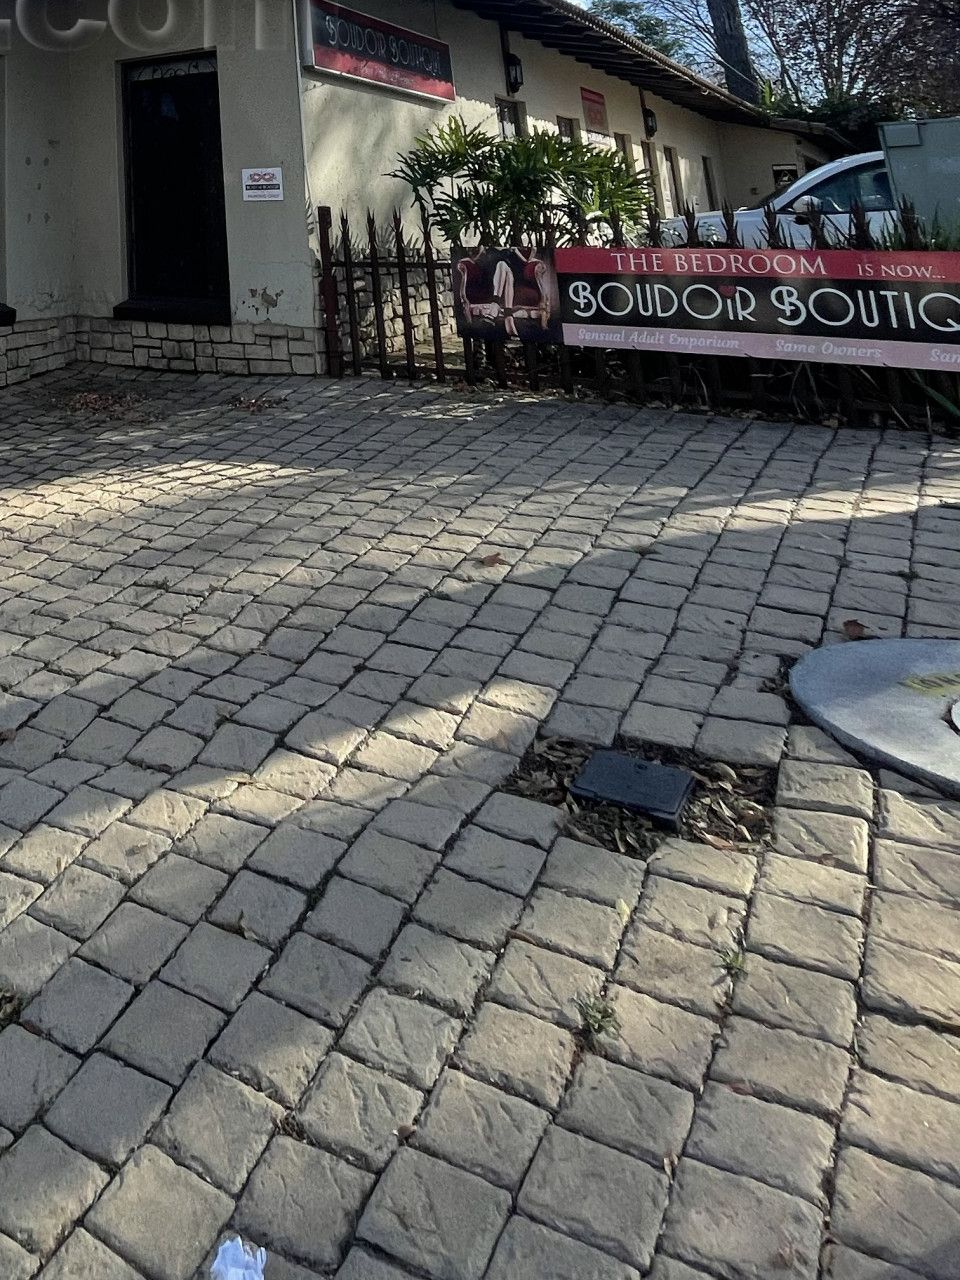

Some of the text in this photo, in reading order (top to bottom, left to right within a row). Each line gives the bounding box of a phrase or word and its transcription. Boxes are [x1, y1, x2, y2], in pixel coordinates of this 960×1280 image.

[610, 253, 946, 279] THE BEDROOM IS NOW...
[568, 281, 757, 321] BOUDOIR
[577, 328, 739, 349] Sensual Adult Emporium
[776, 339, 882, 358] Same Owners
